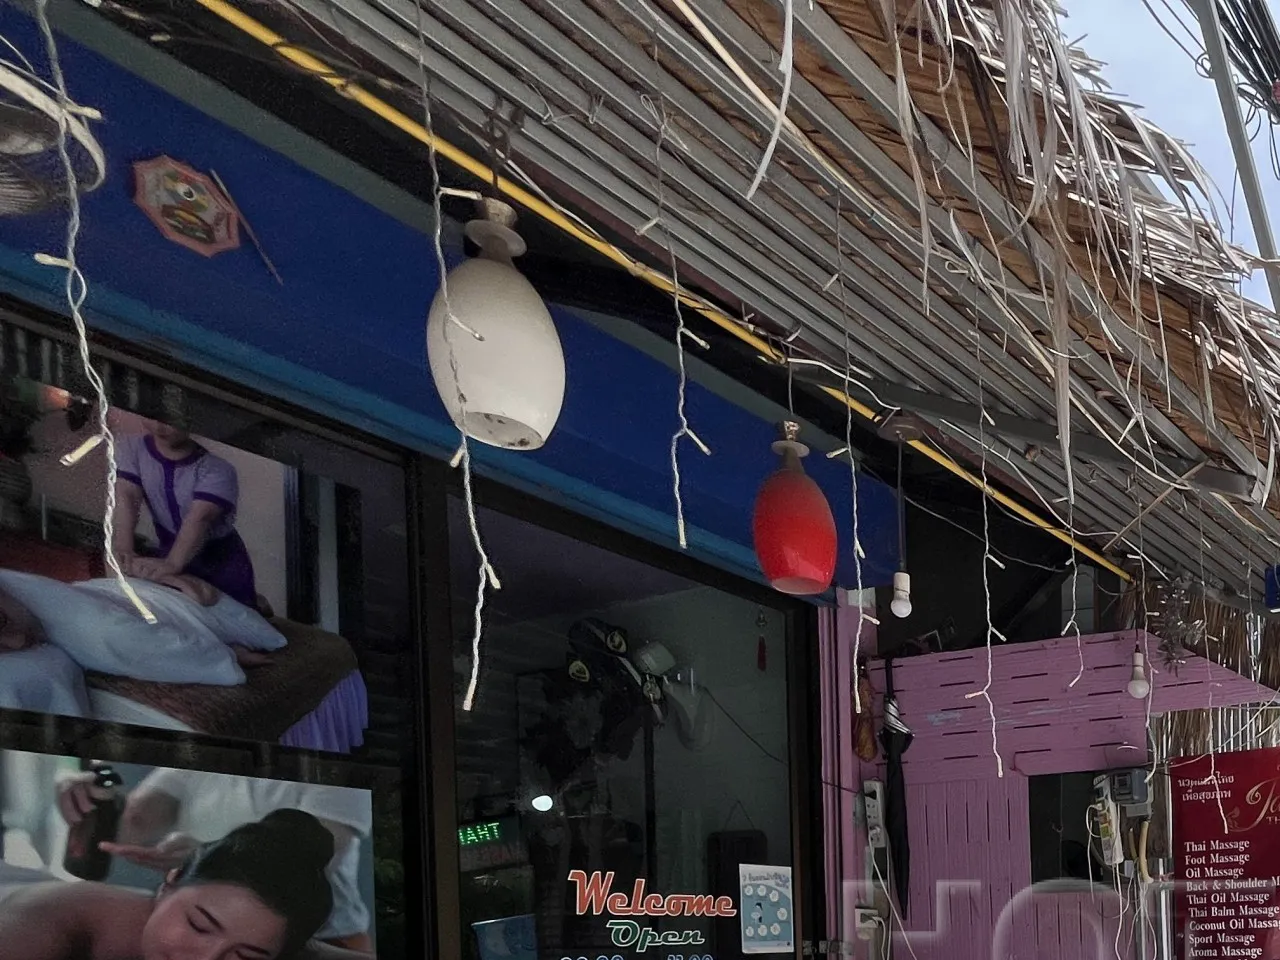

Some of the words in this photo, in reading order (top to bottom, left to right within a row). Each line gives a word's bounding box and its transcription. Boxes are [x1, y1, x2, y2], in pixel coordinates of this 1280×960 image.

[1184, 841, 1206, 852] Thai
[1210, 840, 1250, 852] Massage
[1185, 855, 1206, 865] Foot
[1210, 853, 1250, 865] Massage
[1185, 868, 1201, 878] Oil
[1205, 867, 1244, 879] Massage
[1186, 881, 1208, 891] Back
[1212, 880, 1222, 890] &
[1225, 878, 1268, 889] Shoulder
[567, 870, 738, 916] Welcome
[1186, 893, 1207, 905] Thai
[1211, 893, 1226, 903] Oil
[1230, 892, 1270, 905] Massage
[1188, 907, 1207, 918] Thai
[1211, 906, 1235, 917] Balm
[1239, 905, 1280, 918] Massage
[1189, 920, 1226, 931] Coconut
[1230, 918, 1244, 929] Oil
[606, 920, 705, 952] Open
[1189, 933, 1213, 946] Sport
[1217, 933, 1255, 945] Massage
[1189, 947, 1218, 957] Aroma
[1222, 946, 1263, 959] Massage
